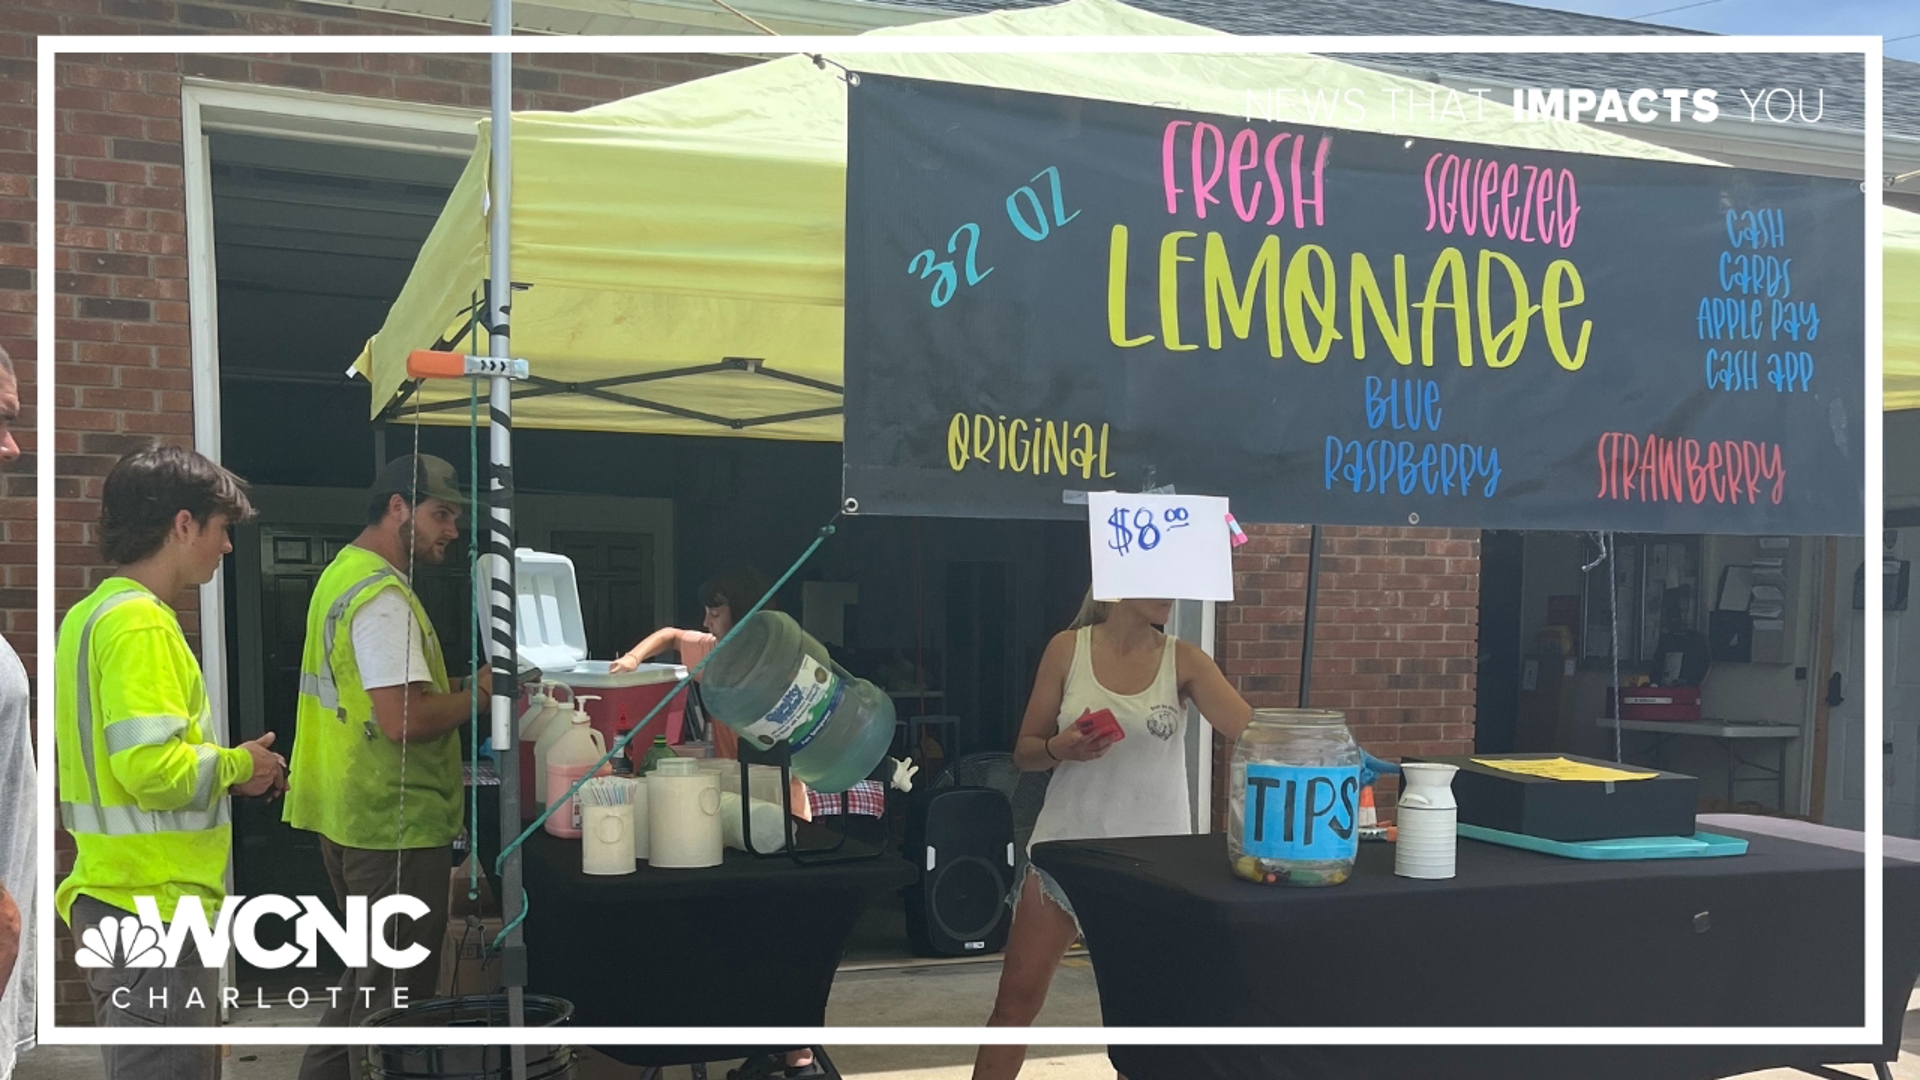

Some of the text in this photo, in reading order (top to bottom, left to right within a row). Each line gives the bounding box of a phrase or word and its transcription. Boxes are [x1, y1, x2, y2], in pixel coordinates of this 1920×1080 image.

[908, 166, 1082, 308] 32 OZ
[1247, 776, 1357, 846] TIPS
